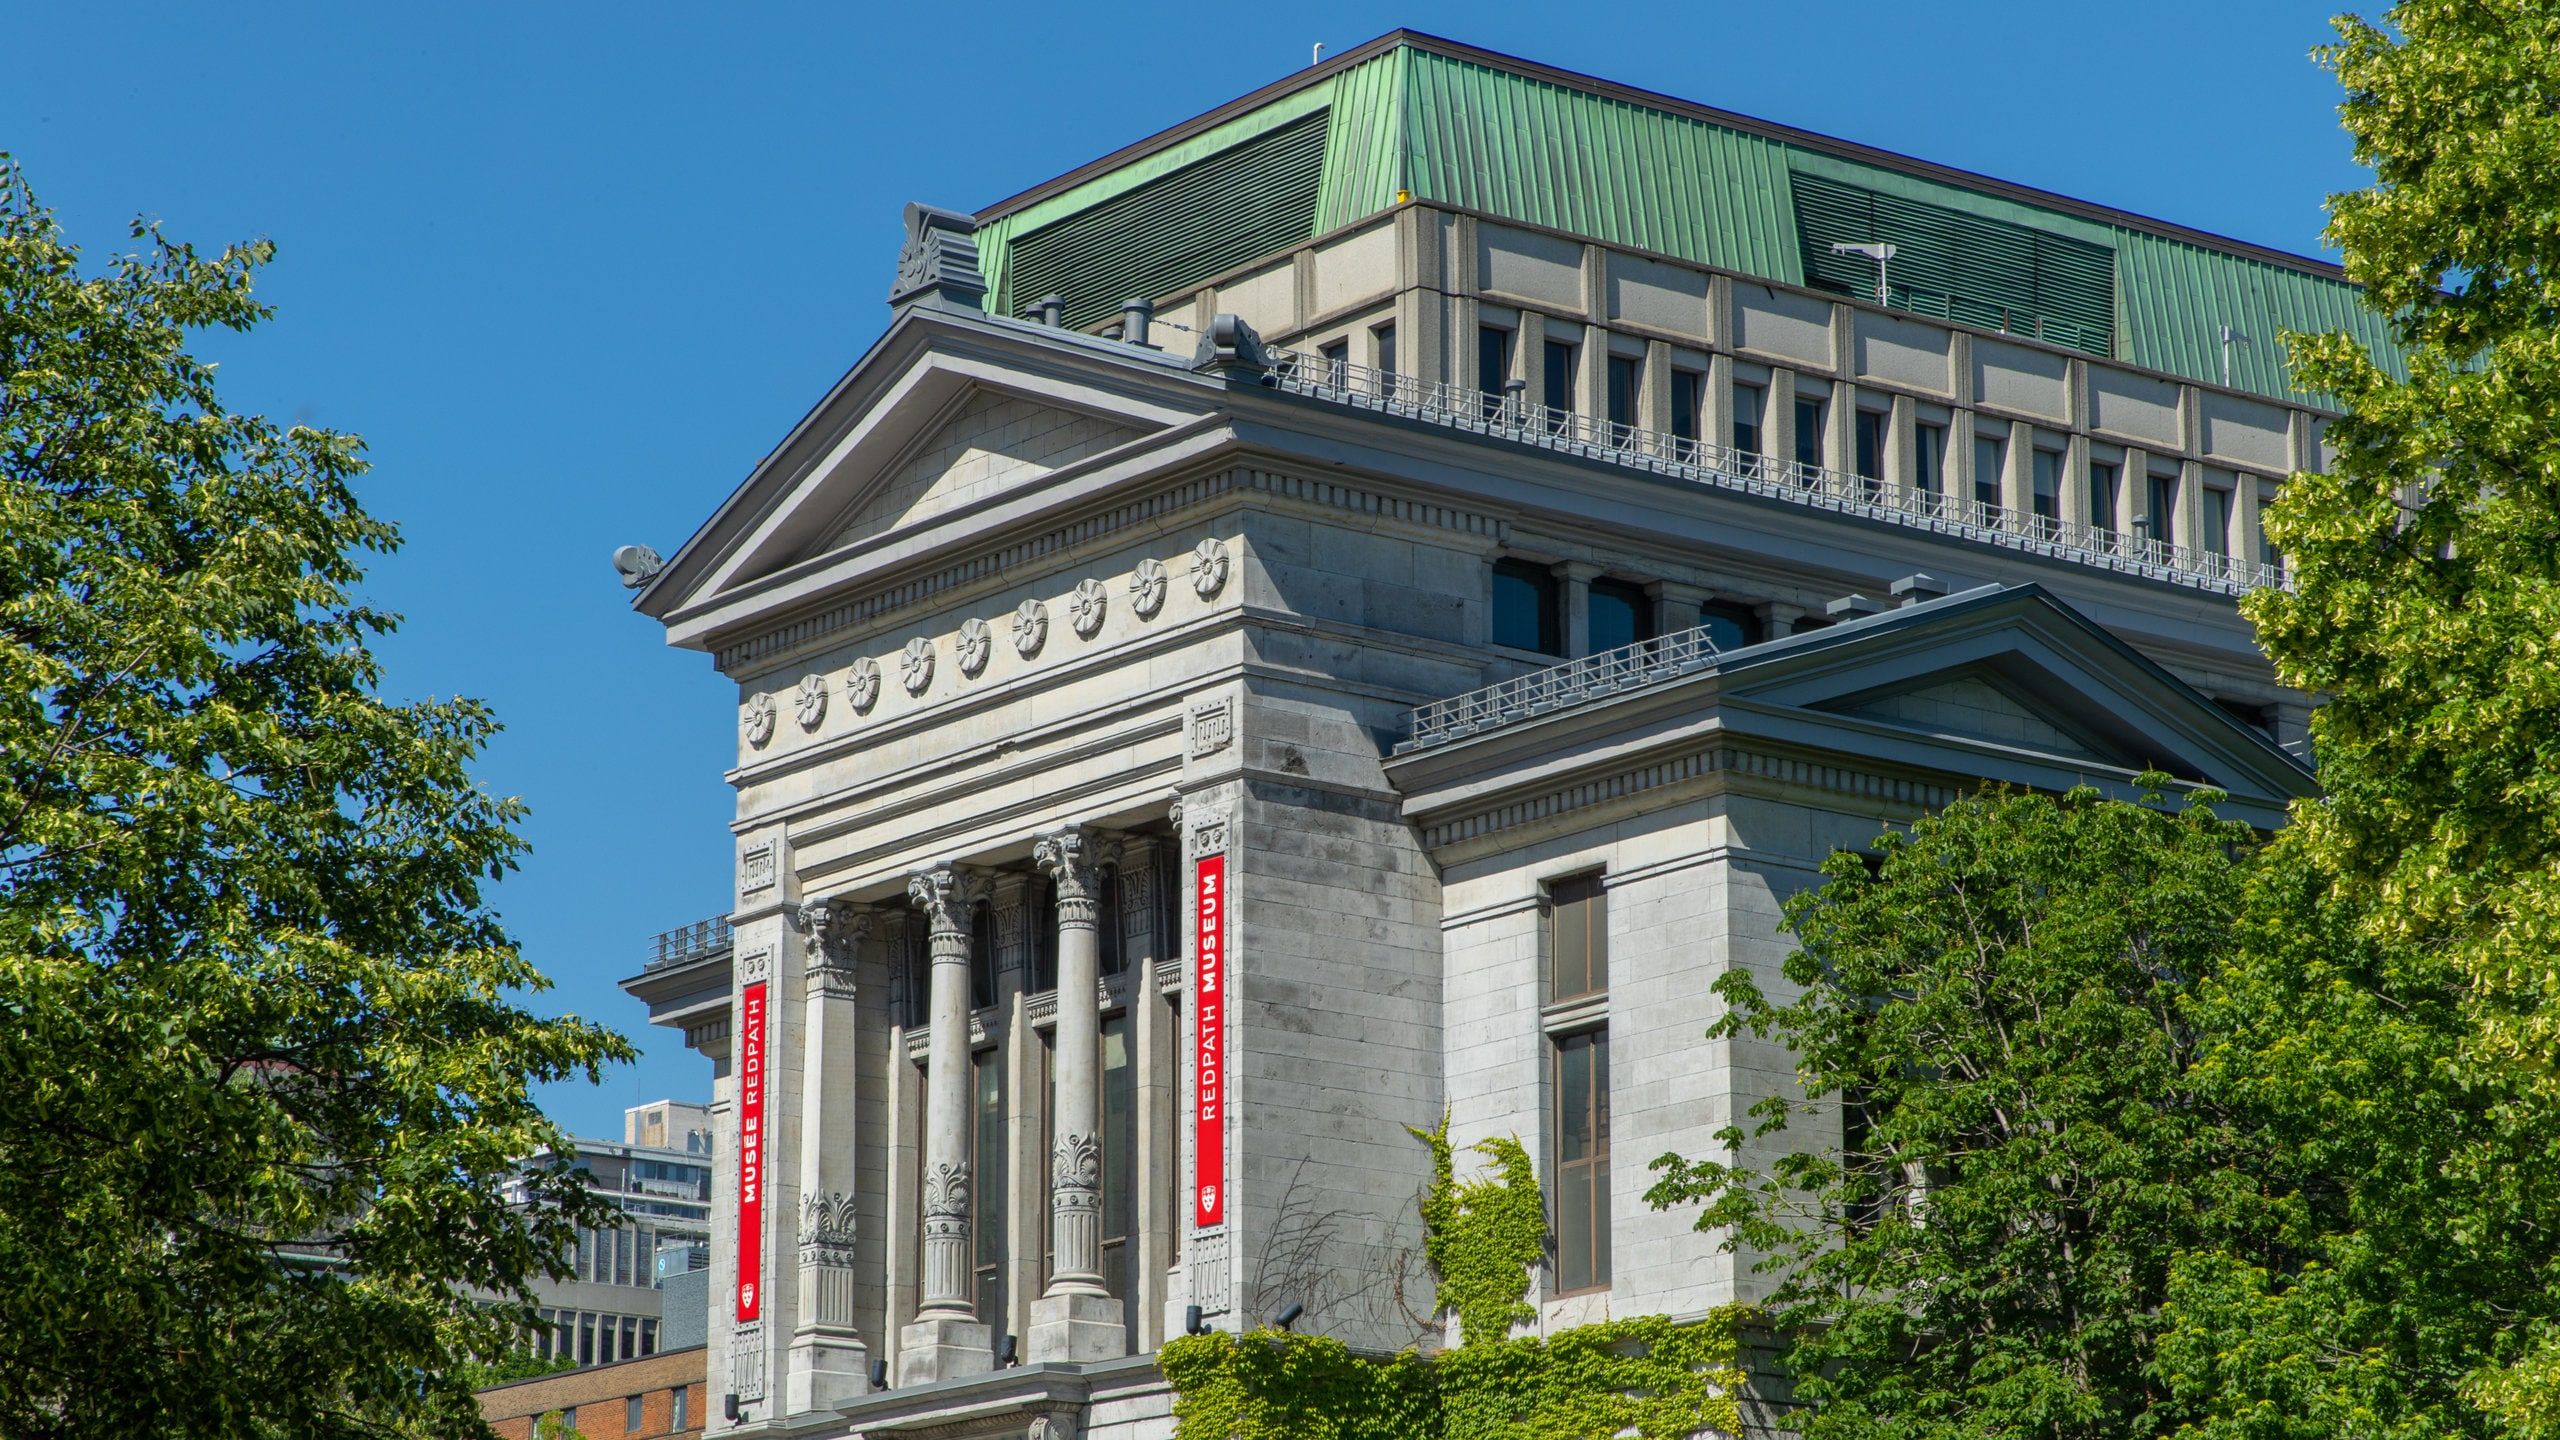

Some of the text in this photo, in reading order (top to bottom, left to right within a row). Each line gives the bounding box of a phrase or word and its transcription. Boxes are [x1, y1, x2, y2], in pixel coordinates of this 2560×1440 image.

[743, 999, 760, 1204] MUSÉE REDPATH
[1202, 873, 1217, 1121] REDPATH MUSEUM
